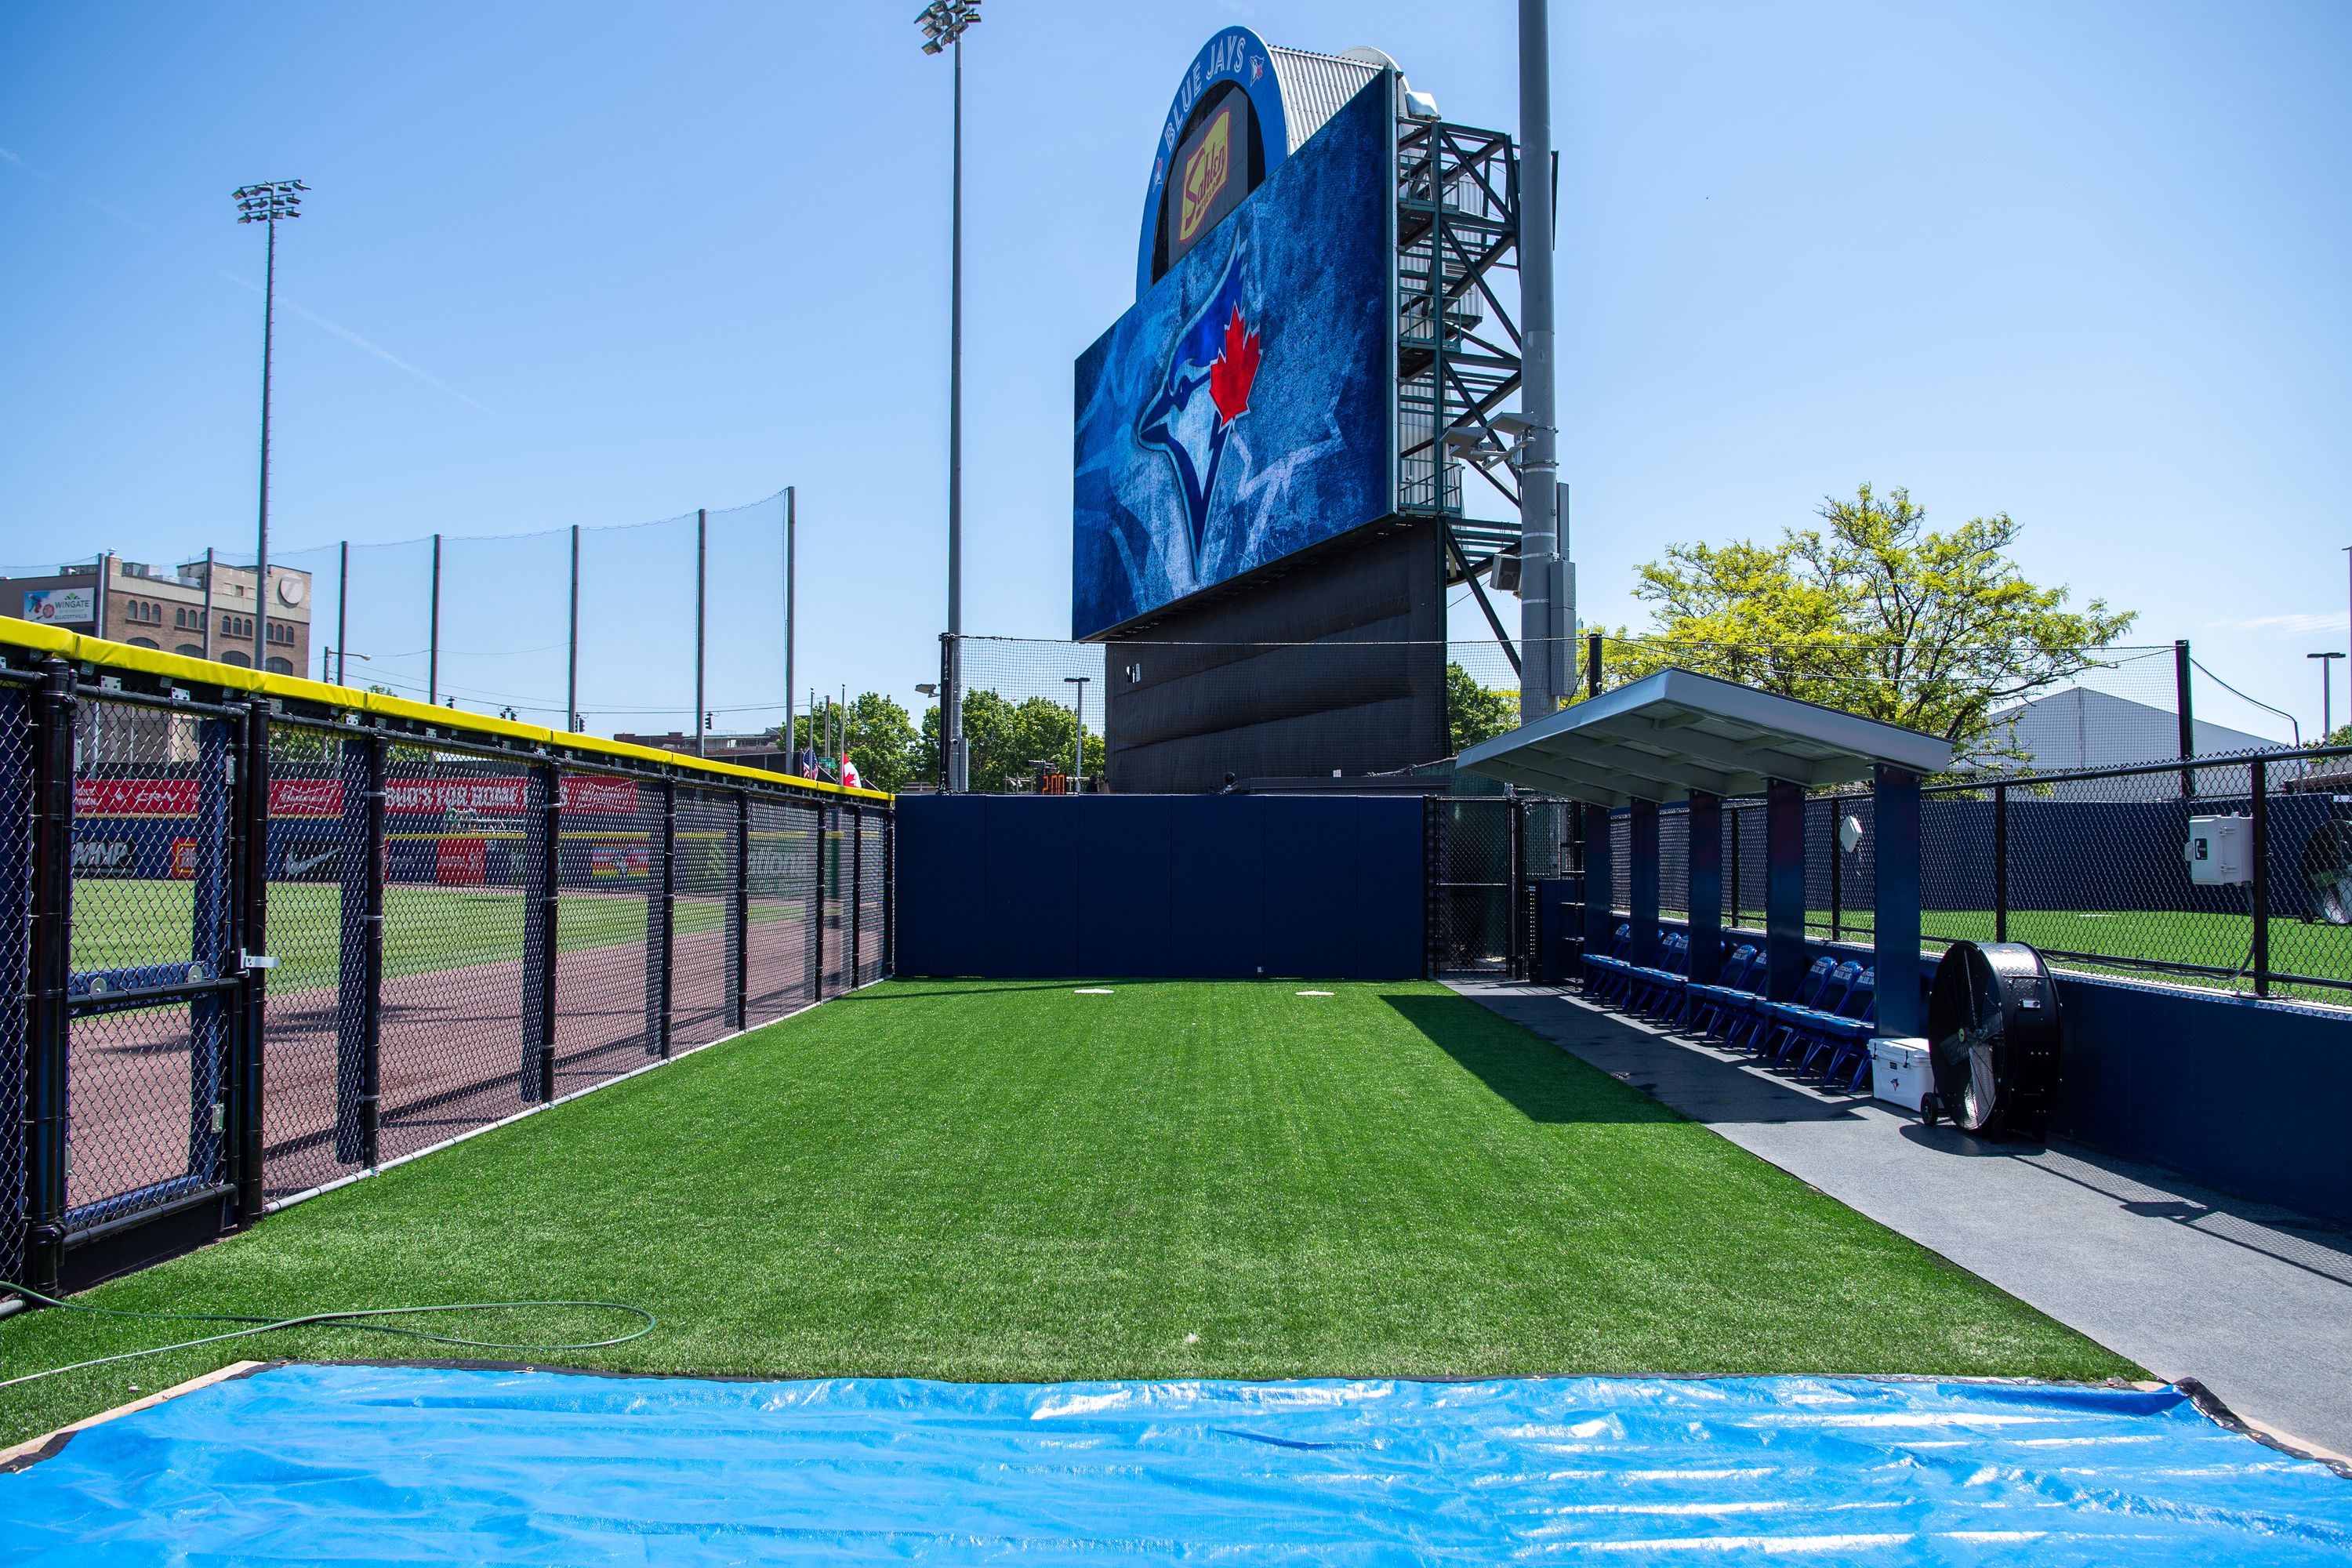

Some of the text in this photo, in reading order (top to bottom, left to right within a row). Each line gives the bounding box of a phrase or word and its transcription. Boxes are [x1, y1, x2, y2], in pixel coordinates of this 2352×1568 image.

[1165, 35, 1247, 153] BLUE JAYS
[384, 786, 433, 807] BUD'S
[436, 786, 468, 807] FOR
[471, 786, 519, 806] HOME
[74, 842, 128, 865] MNP
